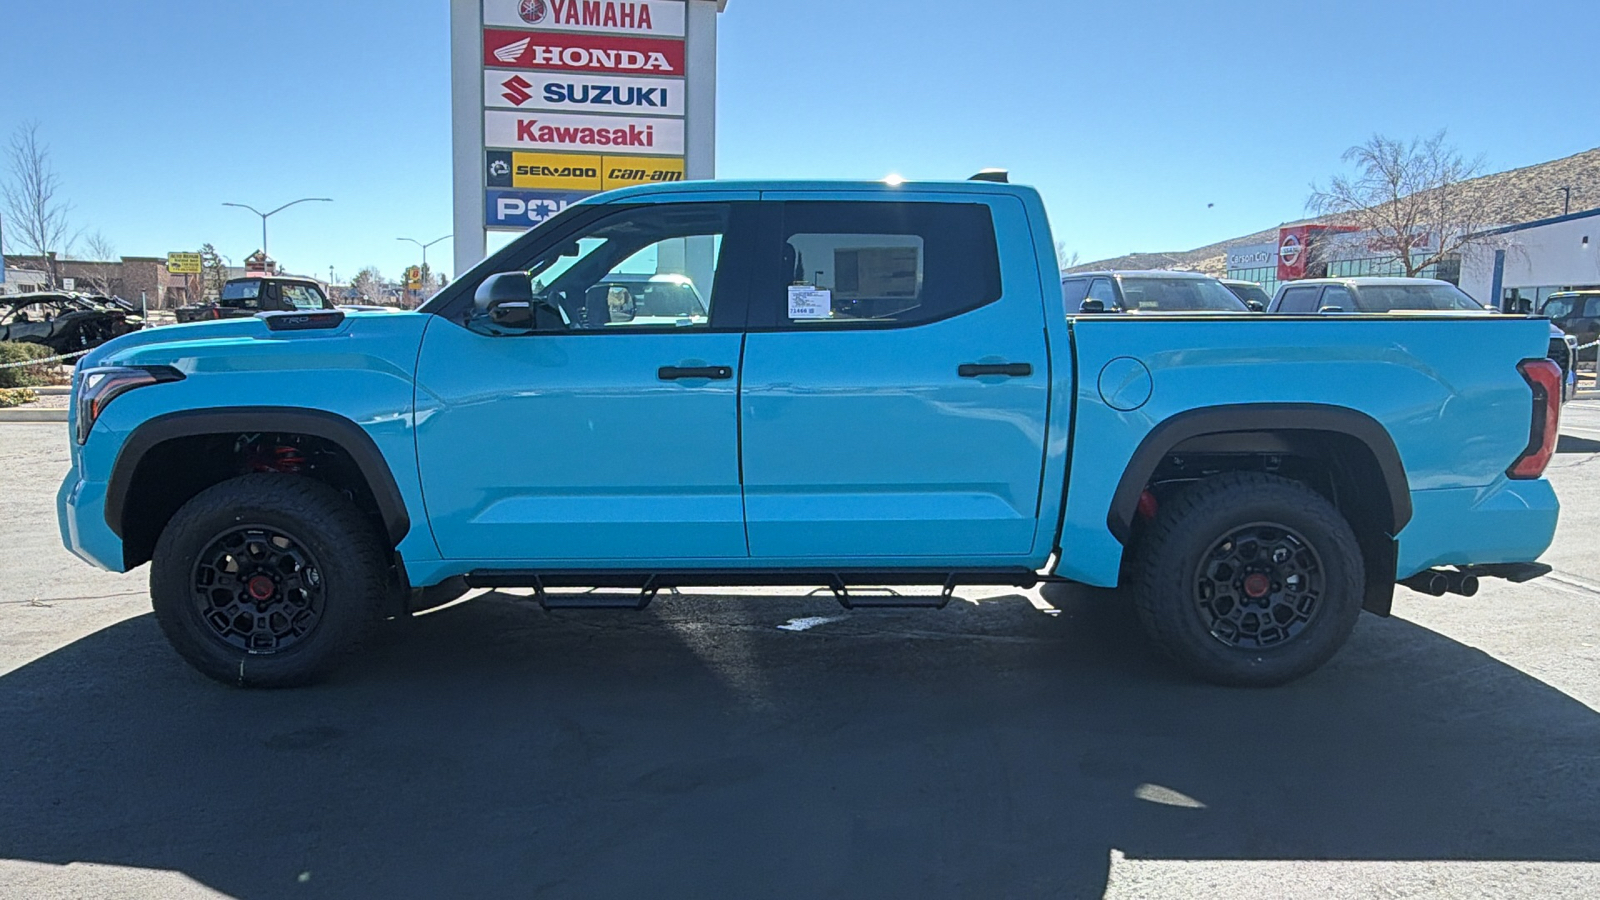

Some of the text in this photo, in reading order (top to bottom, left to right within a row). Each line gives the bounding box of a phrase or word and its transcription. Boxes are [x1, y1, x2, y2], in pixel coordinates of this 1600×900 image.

[550, 0, 653, 29] YAMAHA
[532, 45, 674, 71] HONDA
[543, 82, 668, 108] SUZUKI
[517, 119, 654, 147] Kawasaki
[1230, 251, 1271, 264] Carson City
